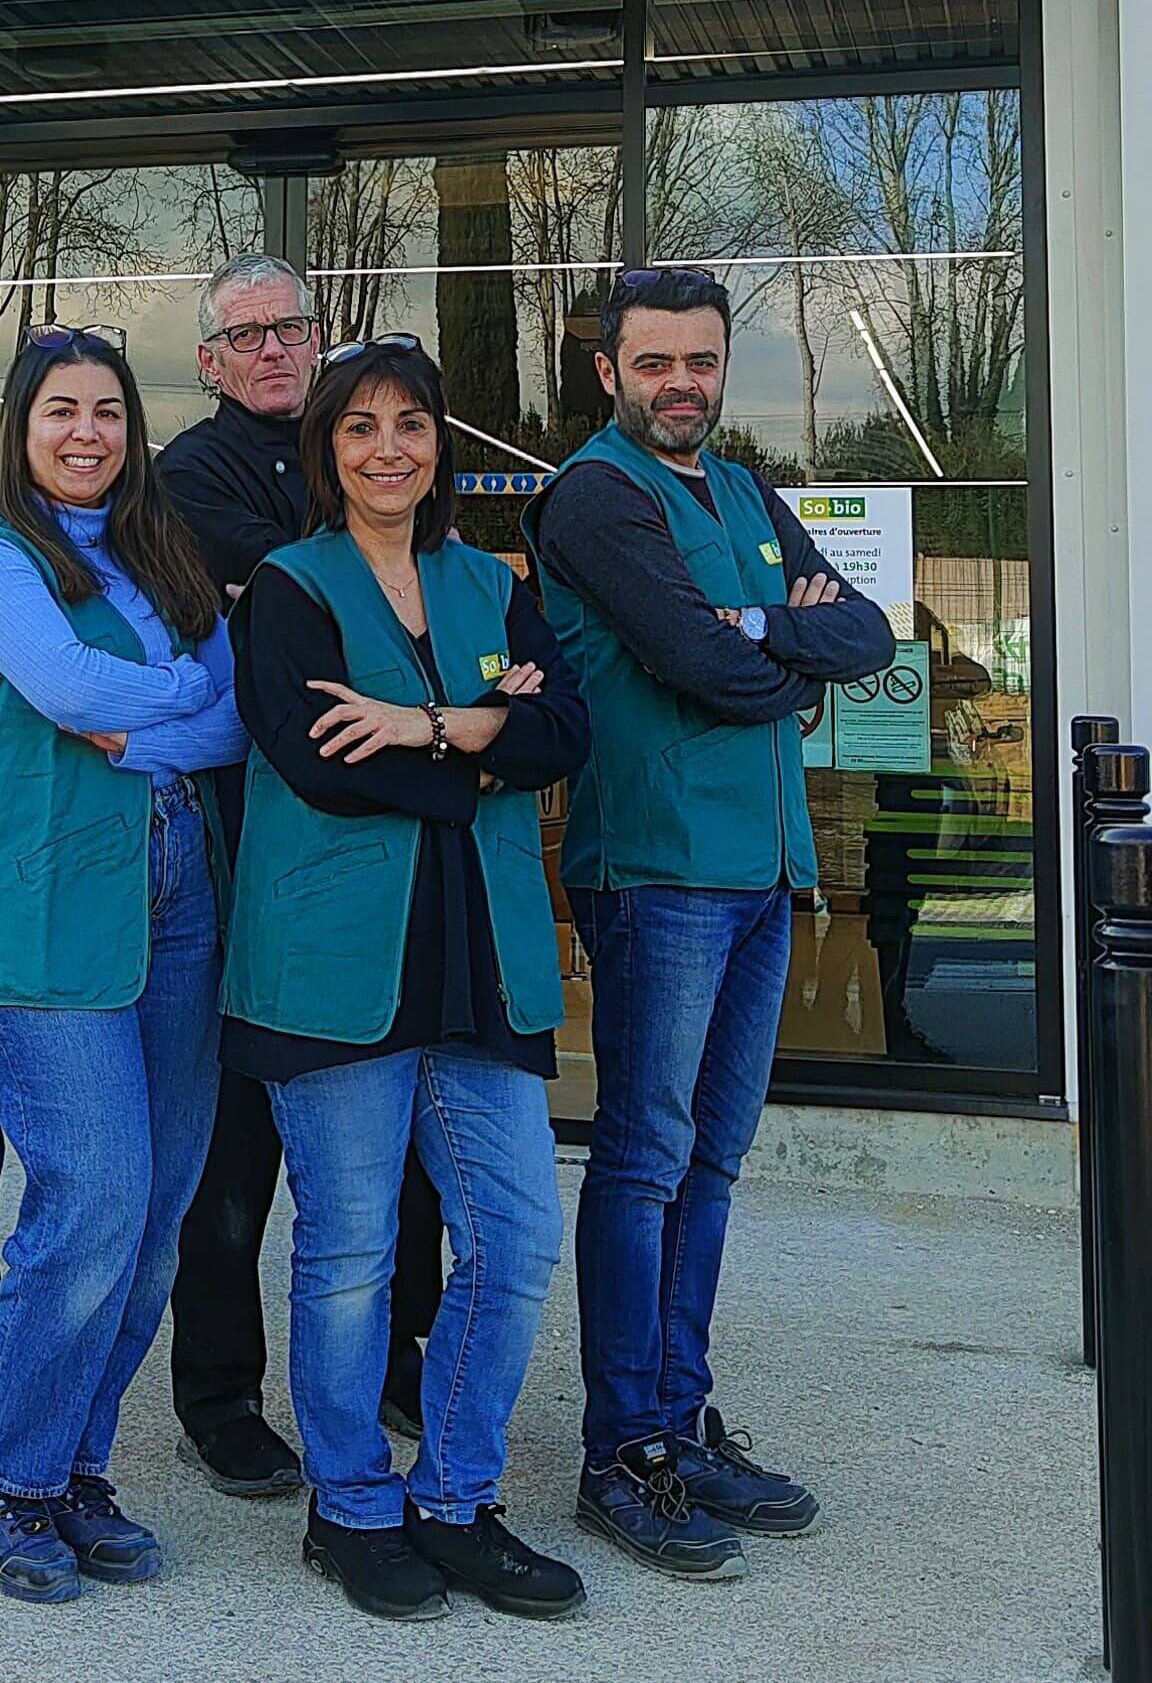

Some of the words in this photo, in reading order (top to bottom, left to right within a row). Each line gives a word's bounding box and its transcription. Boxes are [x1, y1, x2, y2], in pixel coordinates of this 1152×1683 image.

[830, 549, 843, 557] au
[845, 547, 882, 557] samedi
[842, 561, 877, 572] 19h30
